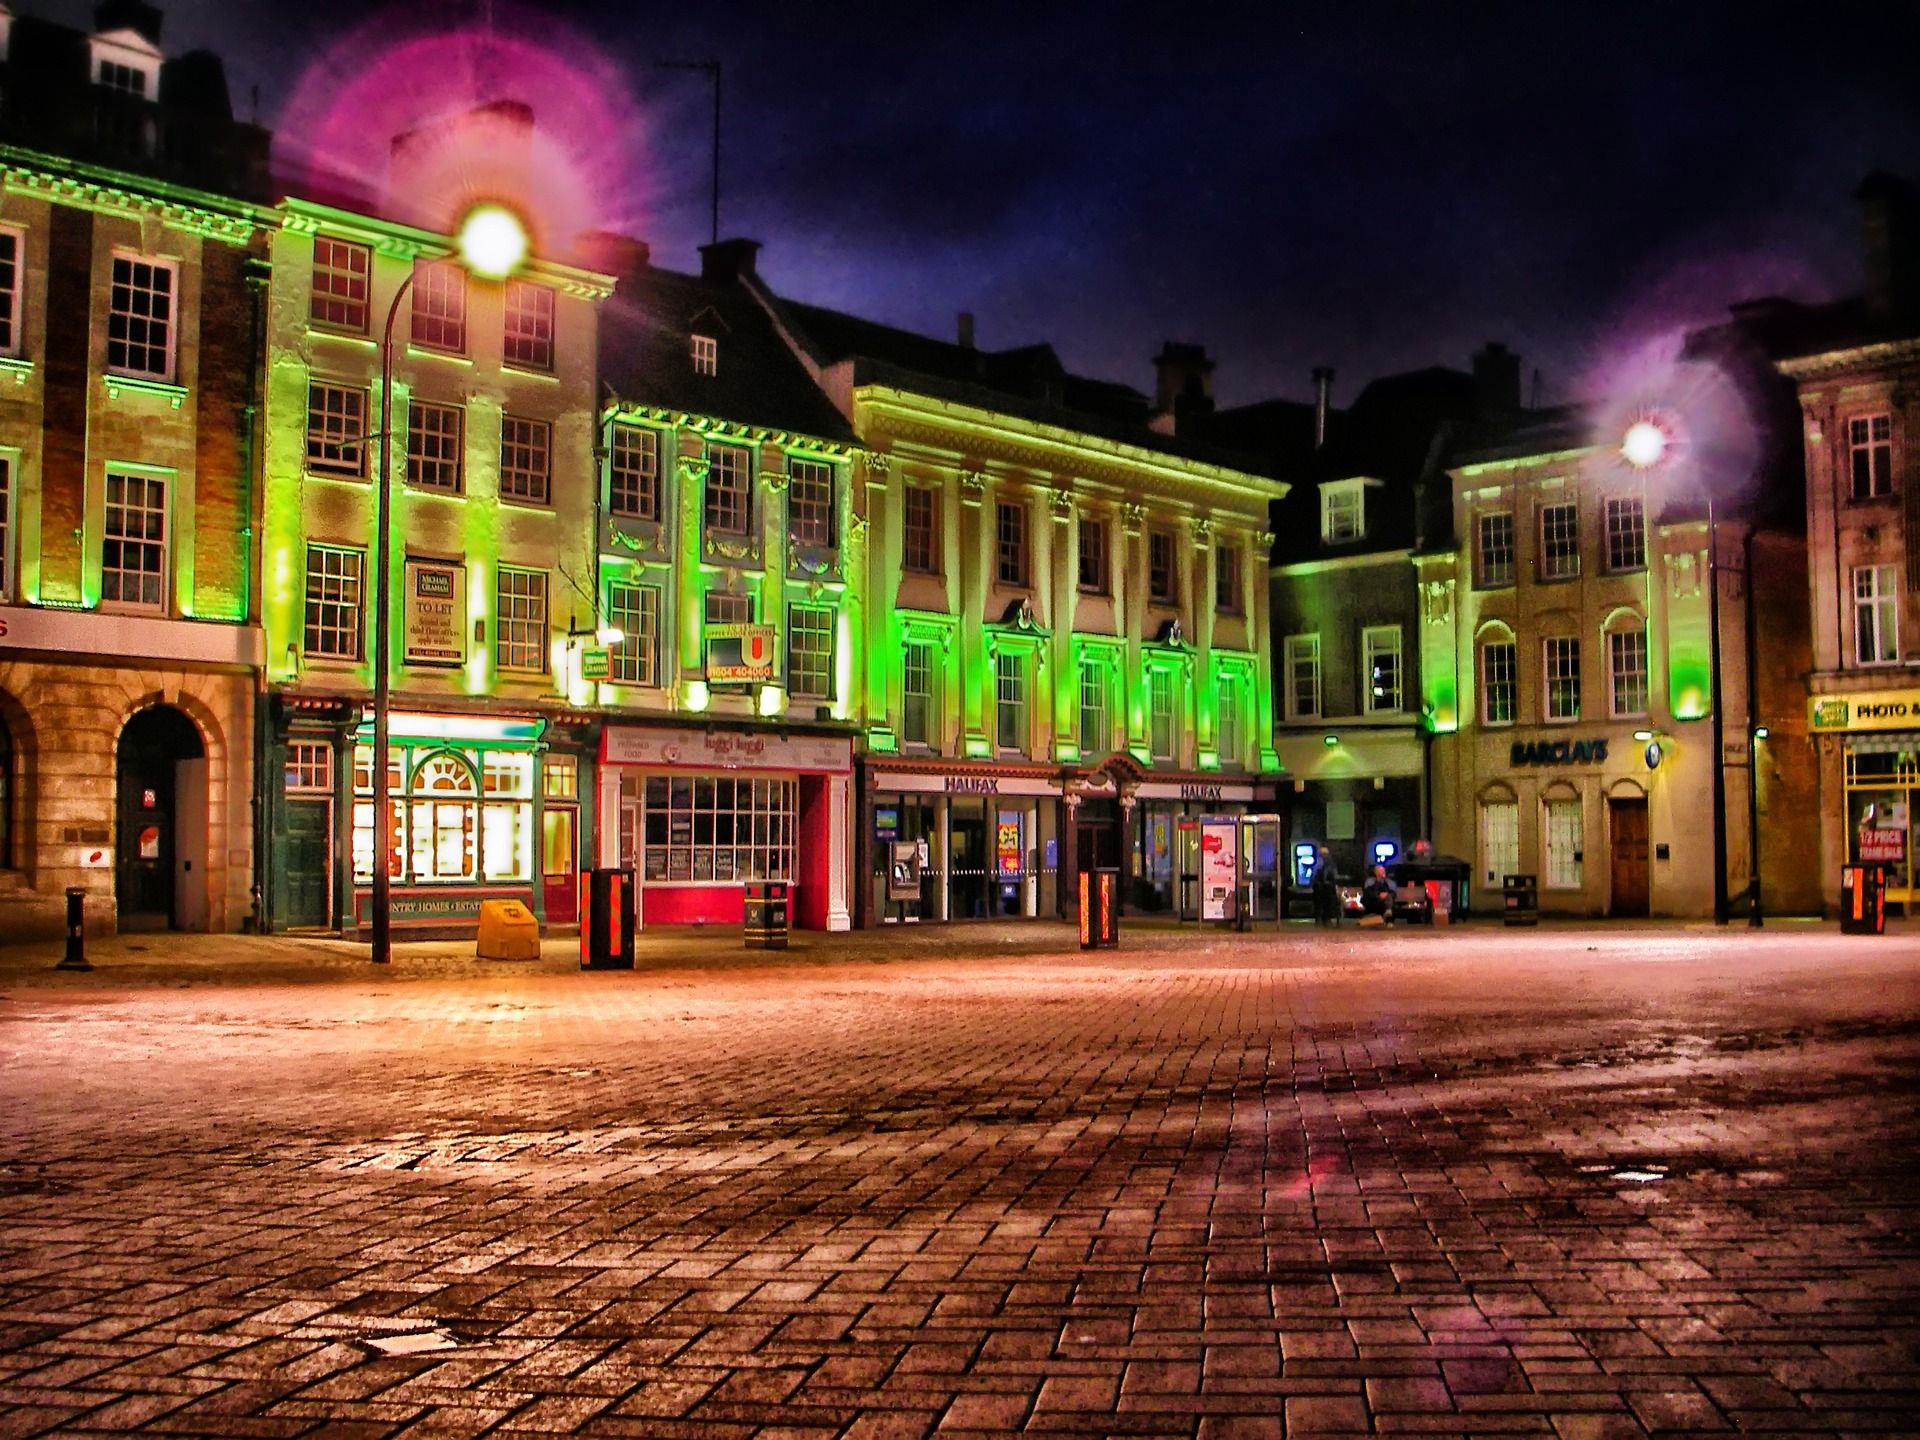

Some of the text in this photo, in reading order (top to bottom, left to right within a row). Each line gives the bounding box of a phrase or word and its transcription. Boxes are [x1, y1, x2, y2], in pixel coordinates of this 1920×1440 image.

[416, 601, 454, 615] TO LET
[1857, 702, 1907, 718] PHOTO
[1510, 738, 1609, 768] BARCLAYS
[945, 776, 998, 793] HALIFAX
[1181, 784, 1222, 798] HALIFAX
[417, 901, 449, 912] HOMES
